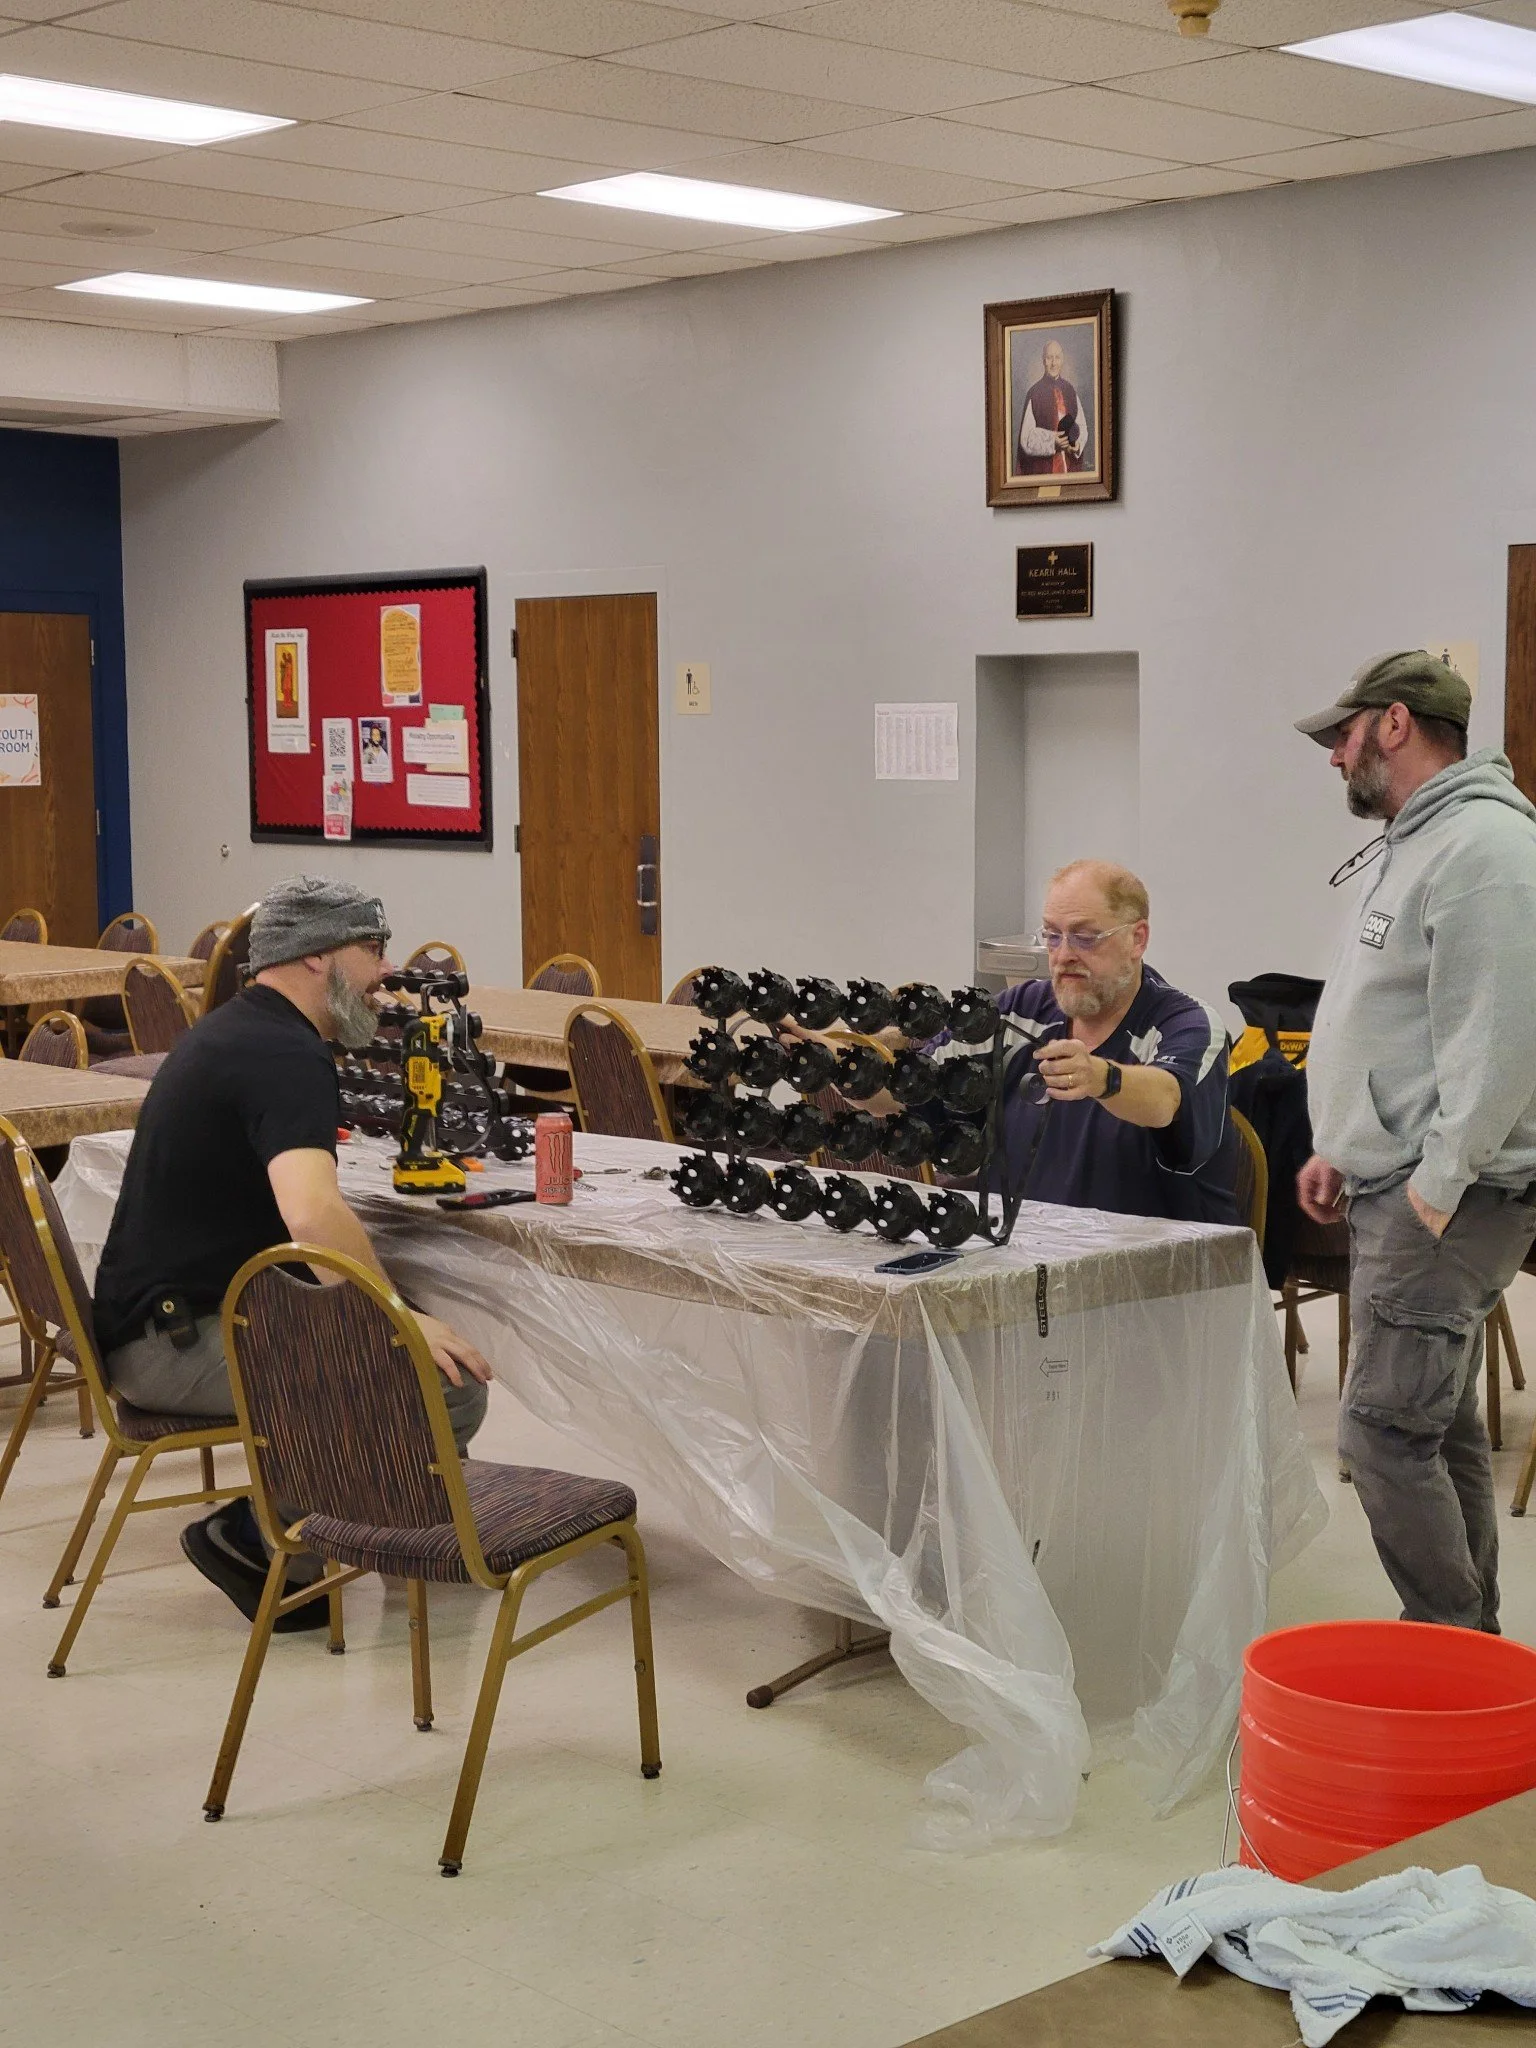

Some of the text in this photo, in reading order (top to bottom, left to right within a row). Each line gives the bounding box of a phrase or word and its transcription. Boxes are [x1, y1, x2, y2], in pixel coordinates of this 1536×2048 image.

[1029, 567, 1077, 577] KEARN HALL
[1038, 1265, 1047, 1333] STEELCOAT
